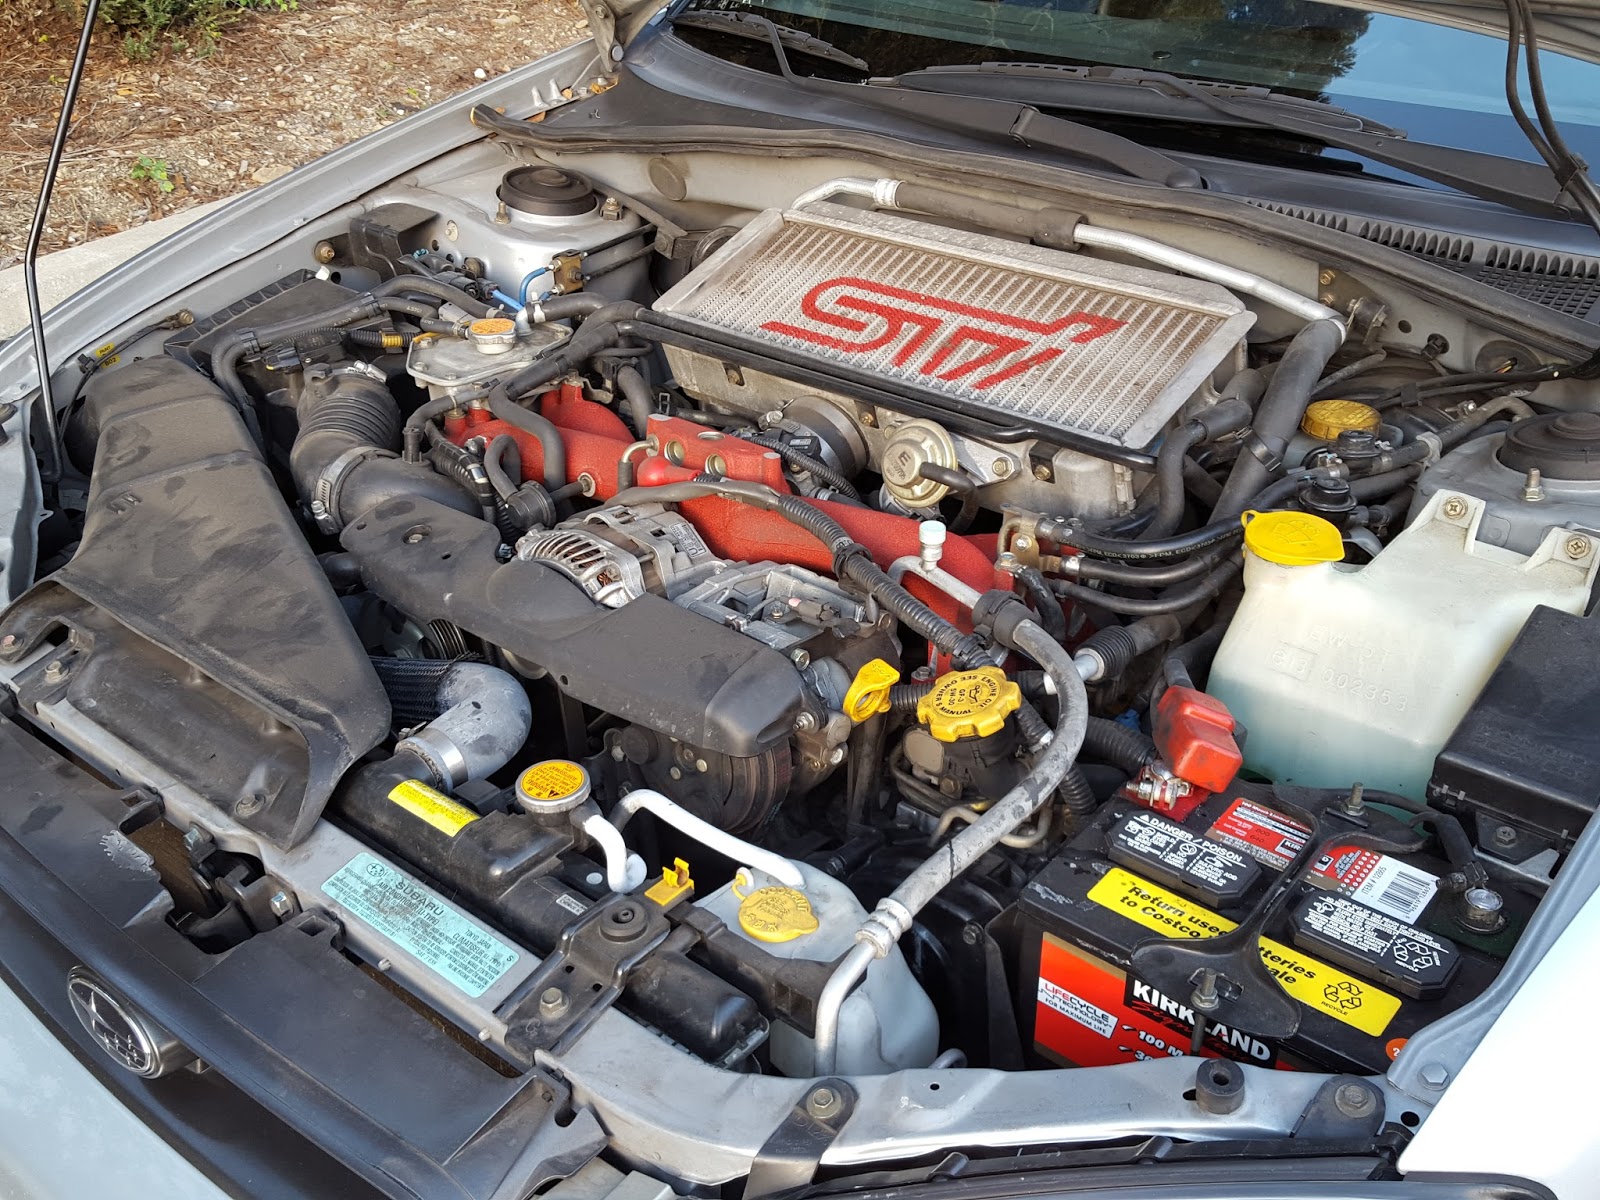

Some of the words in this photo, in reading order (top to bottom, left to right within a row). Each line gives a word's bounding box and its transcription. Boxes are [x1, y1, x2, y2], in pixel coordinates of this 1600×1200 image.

[981, 676, 997, 697] ENGINE
[940, 707, 972, 715] MANUAL
[979, 698, 992, 708] OIL
[1150, 818, 1194, 842] DANGER
[1202, 840, 1243, 862] POISON
[376, 881, 389, 890] AIR
[384, 886, 420, 911] CONDITIONER
[394, 881, 445, 916] SUBARU
[760, 886, 809, 912] COOLANT
[1128, 886, 1186, 917] Return
[1119, 895, 1138, 908] to
[1141, 906, 1201, 938] Costco
[451, 932, 485, 956] CLIMATISEUR
[463, 928, 479, 941] TOKYO
[476, 937, 493, 949] JAPAN
[505, 954, 514, 962] S
[1258, 946, 1316, 980] teries
[1264, 964, 1297, 984] ale
[1044, 983, 1110, 1022] LIFECYCLE
[1045, 997, 1058, 1008] FOR
[1059, 1004, 1093, 1029] MAXIMUM
[1093, 1023, 1108, 1035] LIFE
[1321, 1000, 1349, 1016] RECYCLE
[1133, 979, 1271, 1061] KIRKAND
[1138, 1030, 1166, 1050] 100
[1167, 1045, 1184, 1057] M
